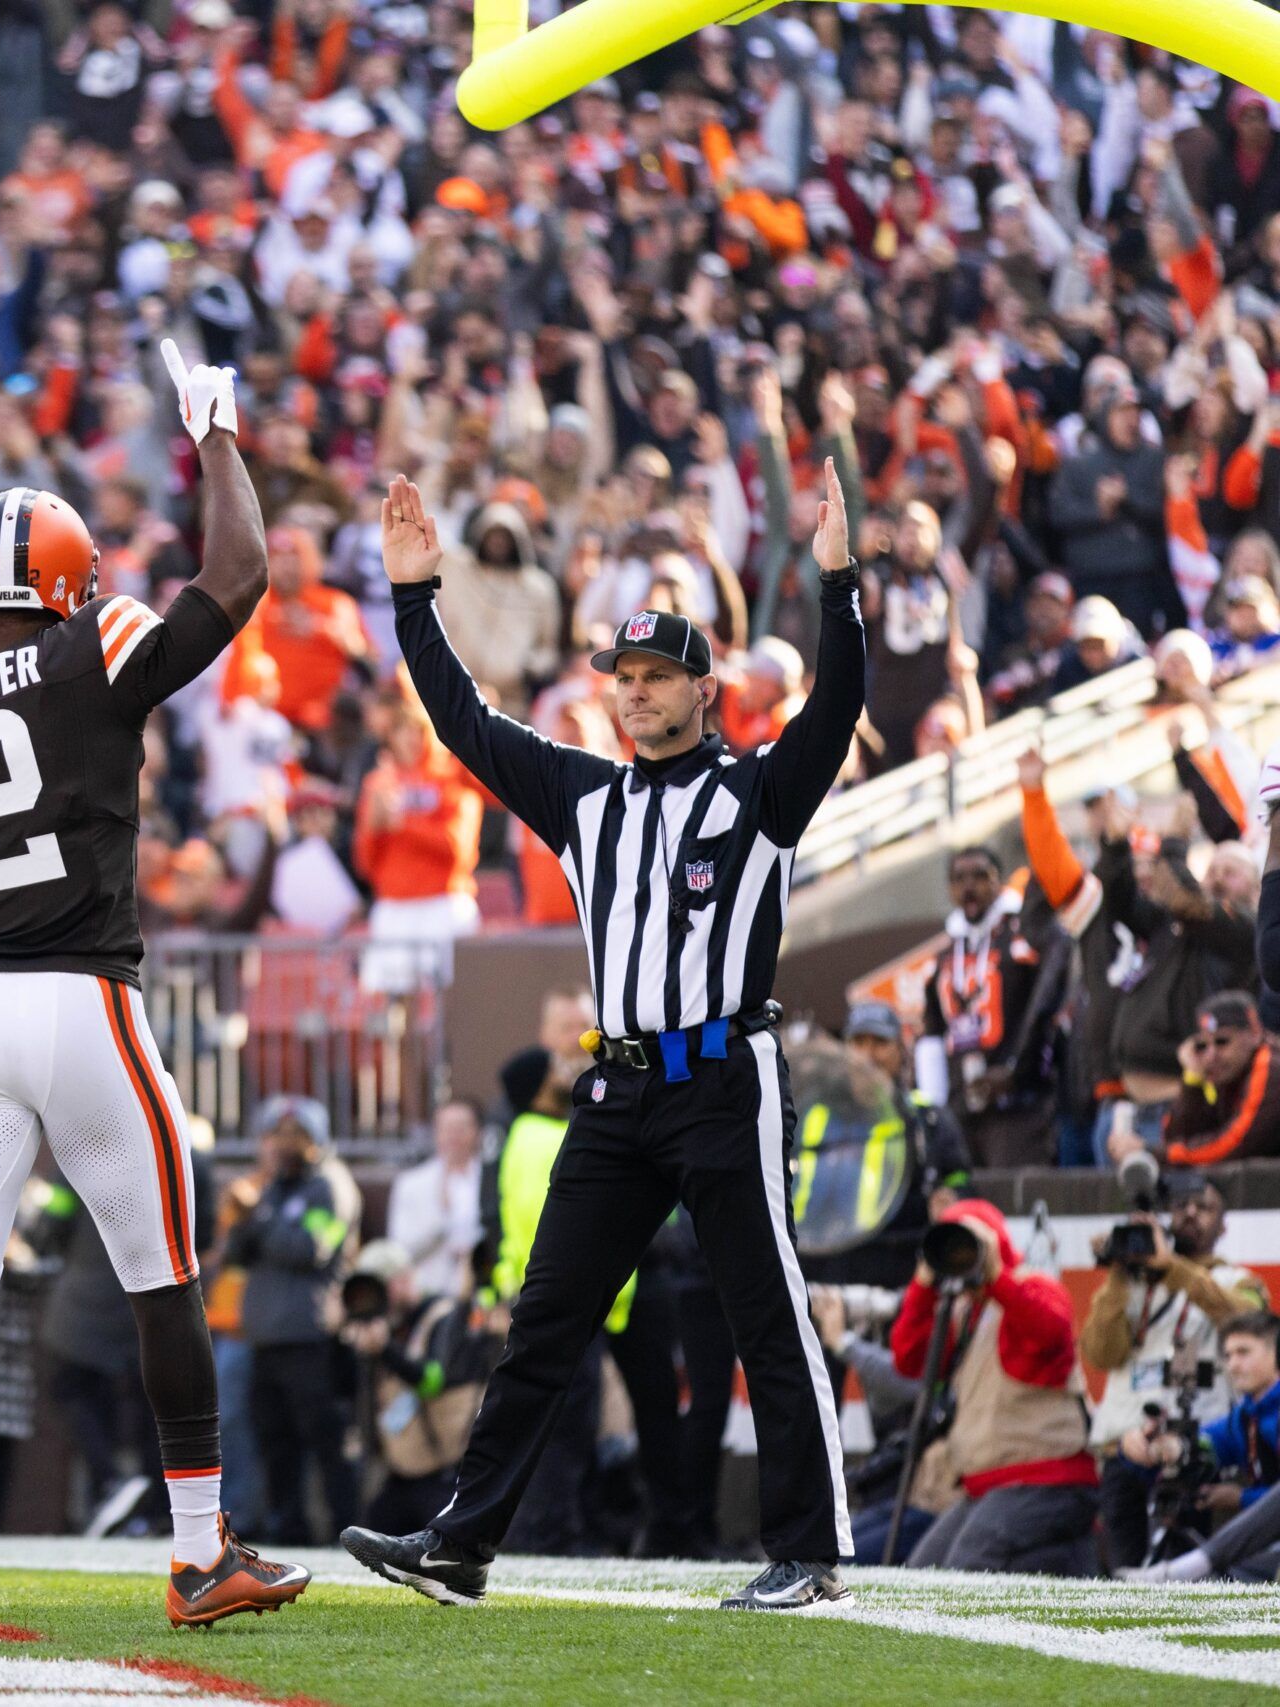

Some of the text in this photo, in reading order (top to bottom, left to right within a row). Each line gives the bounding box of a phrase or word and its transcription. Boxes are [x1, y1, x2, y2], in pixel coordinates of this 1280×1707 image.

[29, 568, 40, 588] 2
[629, 623, 651, 637] NFL
[690, 872, 712, 888] NFL
[190, 1577, 217, 1601] ALPHA
